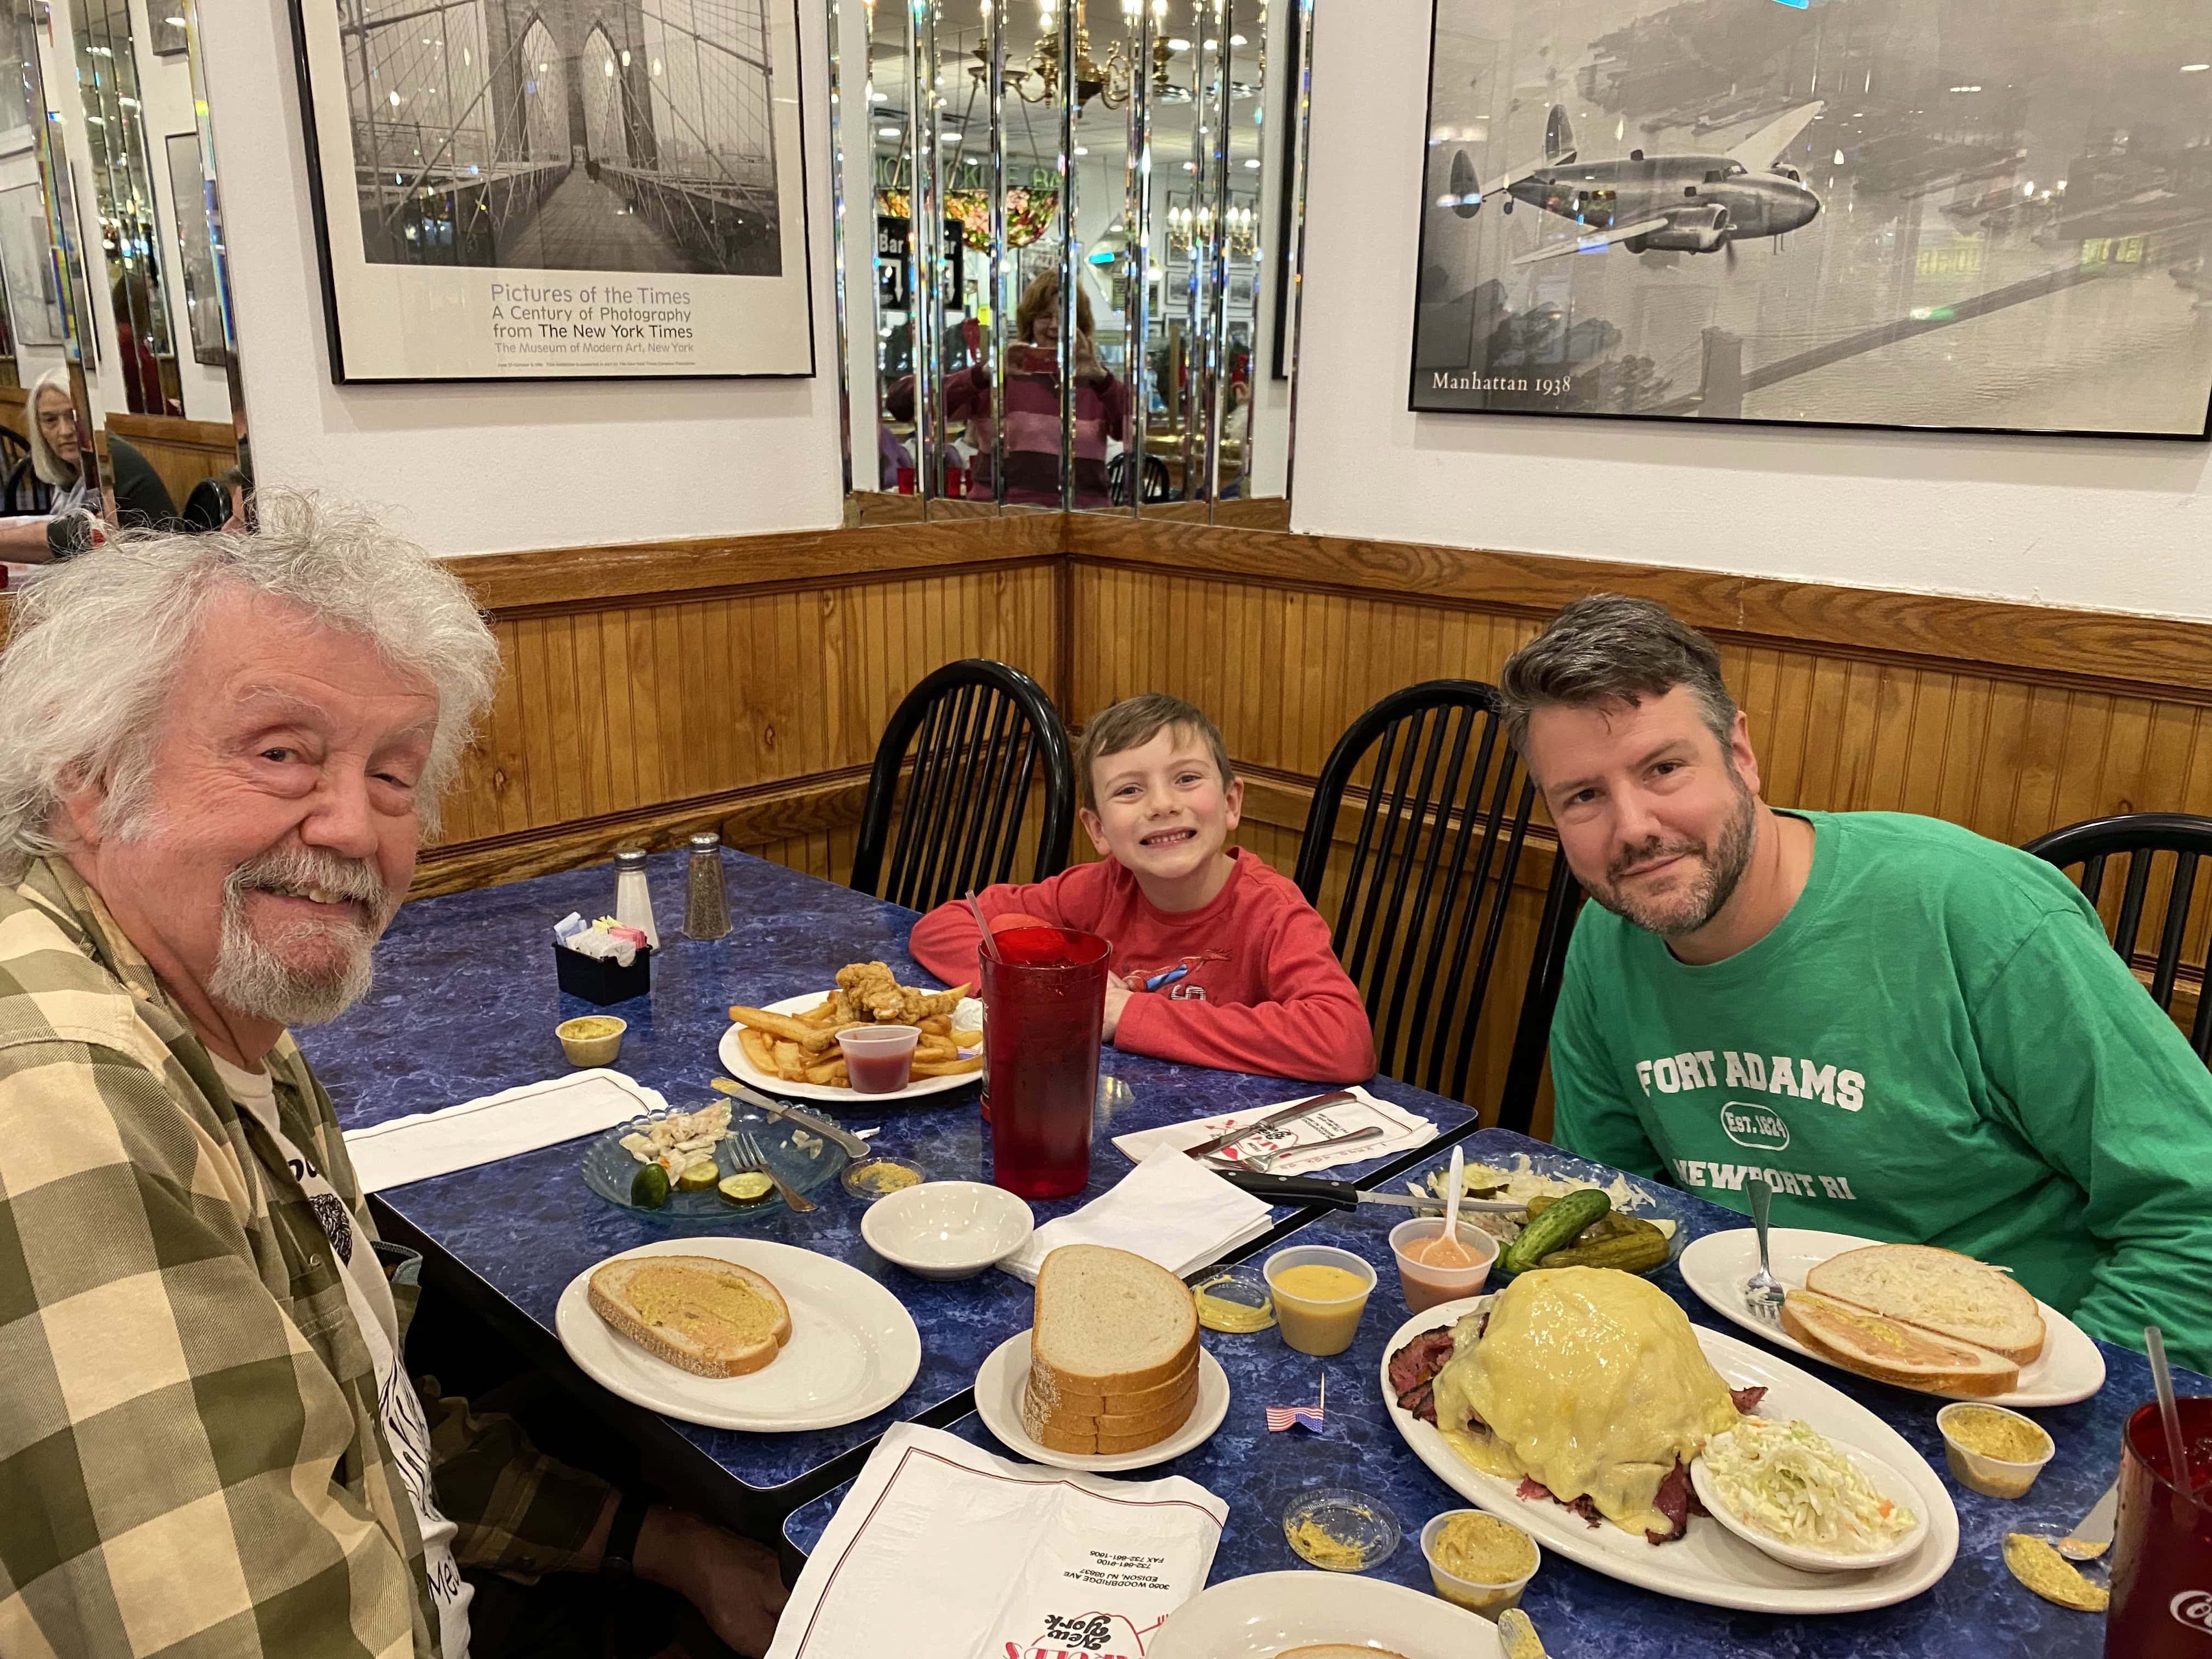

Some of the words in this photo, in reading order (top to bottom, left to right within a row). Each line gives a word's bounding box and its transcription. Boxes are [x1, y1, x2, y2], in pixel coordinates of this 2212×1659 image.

[879, 233, 904, 253] Bar
[491, 284, 573, 303] Pictures
[580, 286, 596, 303] of
[605, 286, 633, 304] the
[637, 288, 691, 304] Times
[492, 306, 504, 320] A
[511, 306, 573, 323] Century
[579, 307, 593, 321] of
[600, 307, 691, 323] Photography
[493, 324, 533, 339] from
[538, 324, 567, 339] The
[573, 325, 606, 339] New
[611, 325, 644, 339] York
[648, 325, 693, 339] Times
[495, 343, 516, 353] The
[519, 343, 567, 353] Museum
[569, 342, 580, 353] of
[582, 342, 622, 353] Modern
[625, 343, 645, 354] Art,
[647, 342, 671, 353] New
[672, 342, 694, 353] York
[1432, 371, 1528, 391] Manhattan
[1534, 375, 1571, 396] 1938
[1636, 1051, 1717, 1098] FORT
[1723, 1051, 1866, 1112] ADAMS
[1818, 1176, 1857, 1200] RI
[1063, 1571, 1082, 1580] AVE
[1080, 1568, 1105, 1577] 08837
[1082, 1576, 1147, 1588] WOODBRIDGE
[1045, 1615, 1111, 1634] York
[1047, 1629, 1111, 1651] New
